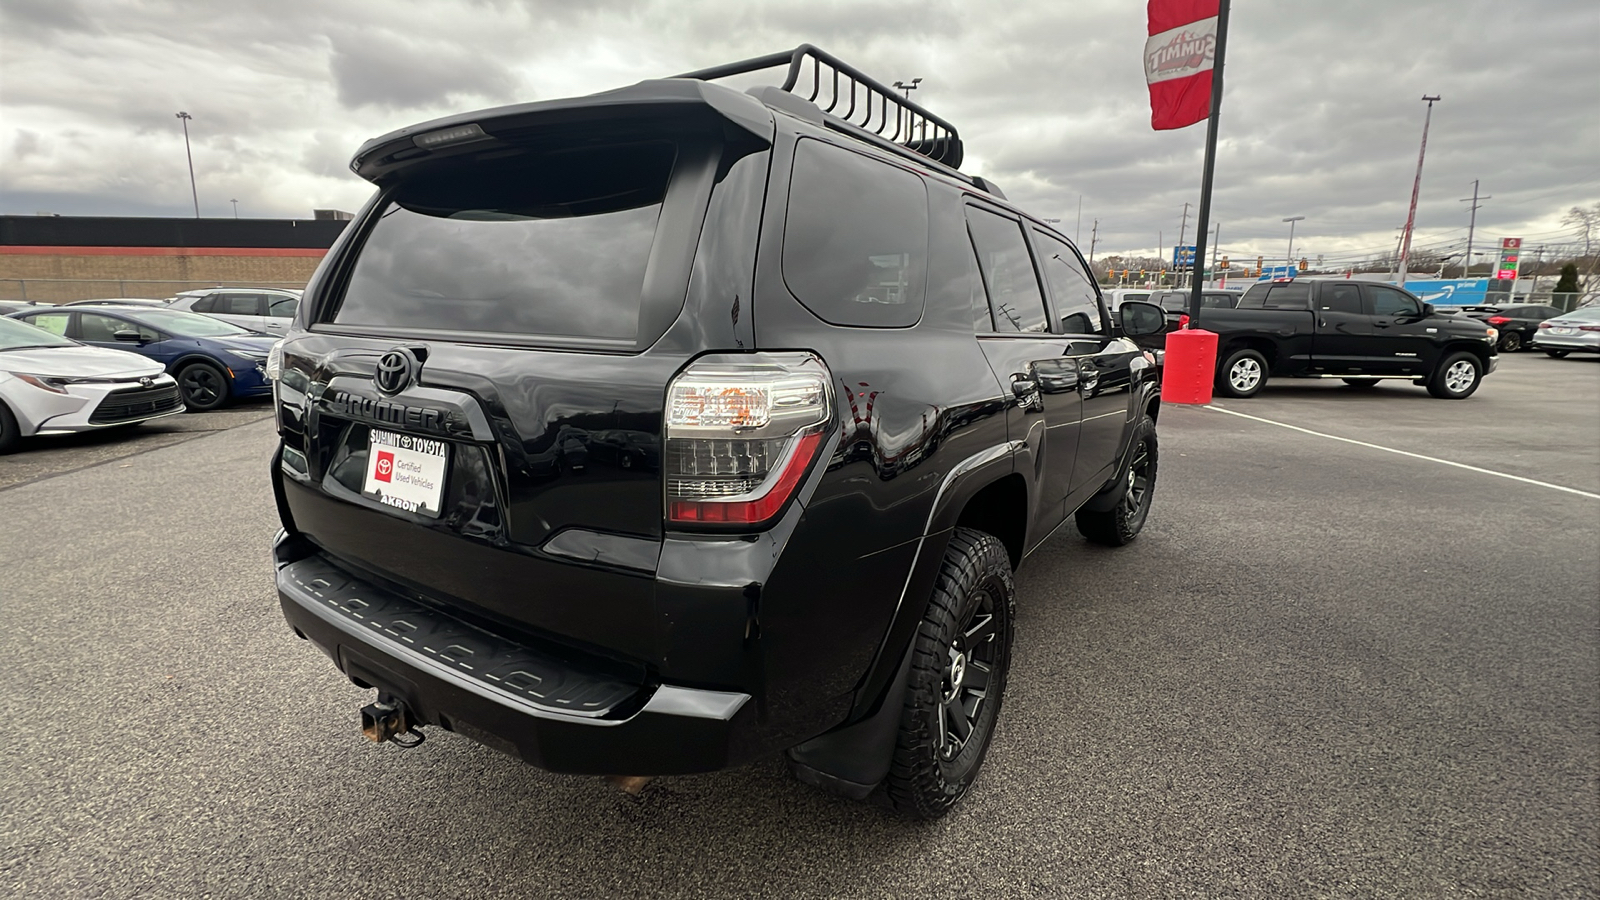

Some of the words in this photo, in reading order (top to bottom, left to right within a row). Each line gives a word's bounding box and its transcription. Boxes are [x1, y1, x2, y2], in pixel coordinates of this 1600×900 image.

[370, 429, 401, 448] SUMMIT
[412, 437, 445, 457] TOYOTA
[397, 460, 421, 473] Certified
[395, 472, 410, 484] Used
[411, 475, 434, 490] Vehicles
[381, 495, 418, 513] AKRON
